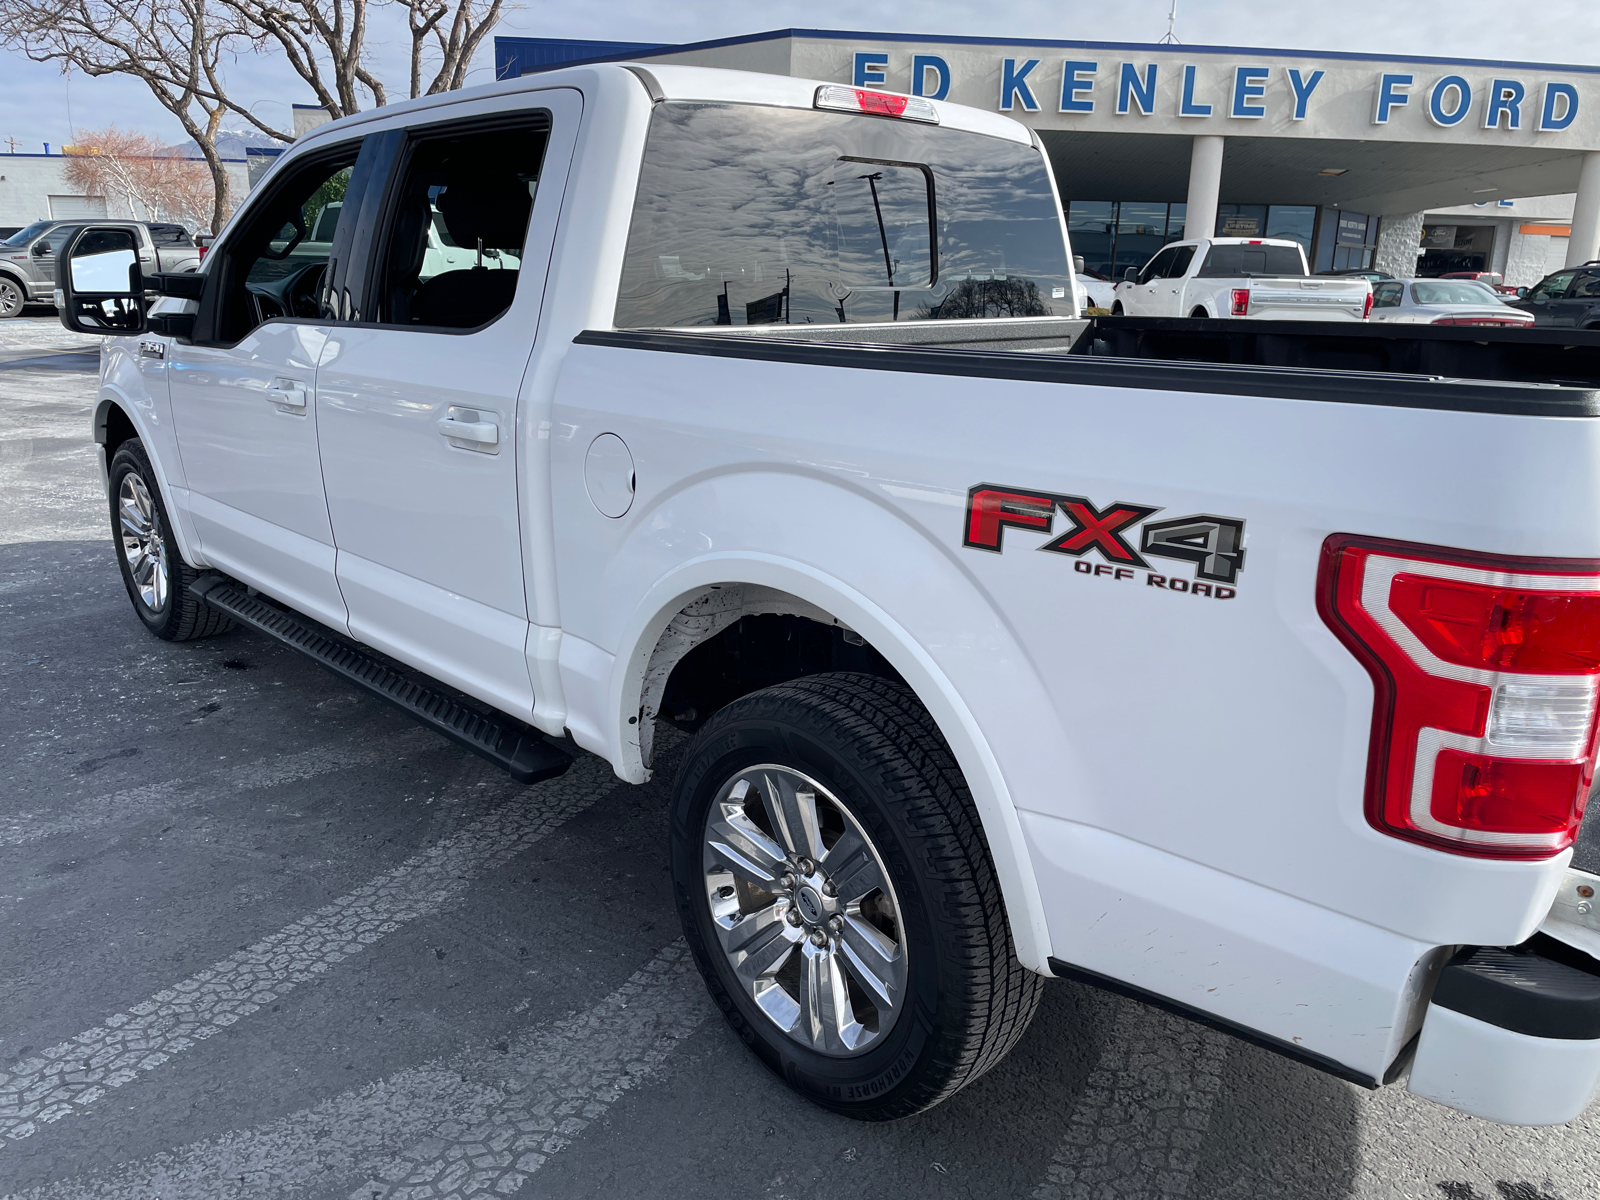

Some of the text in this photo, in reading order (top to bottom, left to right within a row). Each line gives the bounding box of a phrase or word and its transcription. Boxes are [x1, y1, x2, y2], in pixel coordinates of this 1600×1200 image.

[852, 52, 1579, 132] ED KENLEY FORD
[962, 482, 1247, 587] FX4
[1074, 560, 1236, 600] OFF ROAD
[847, 1047, 916, 1098] WORKHORSE
